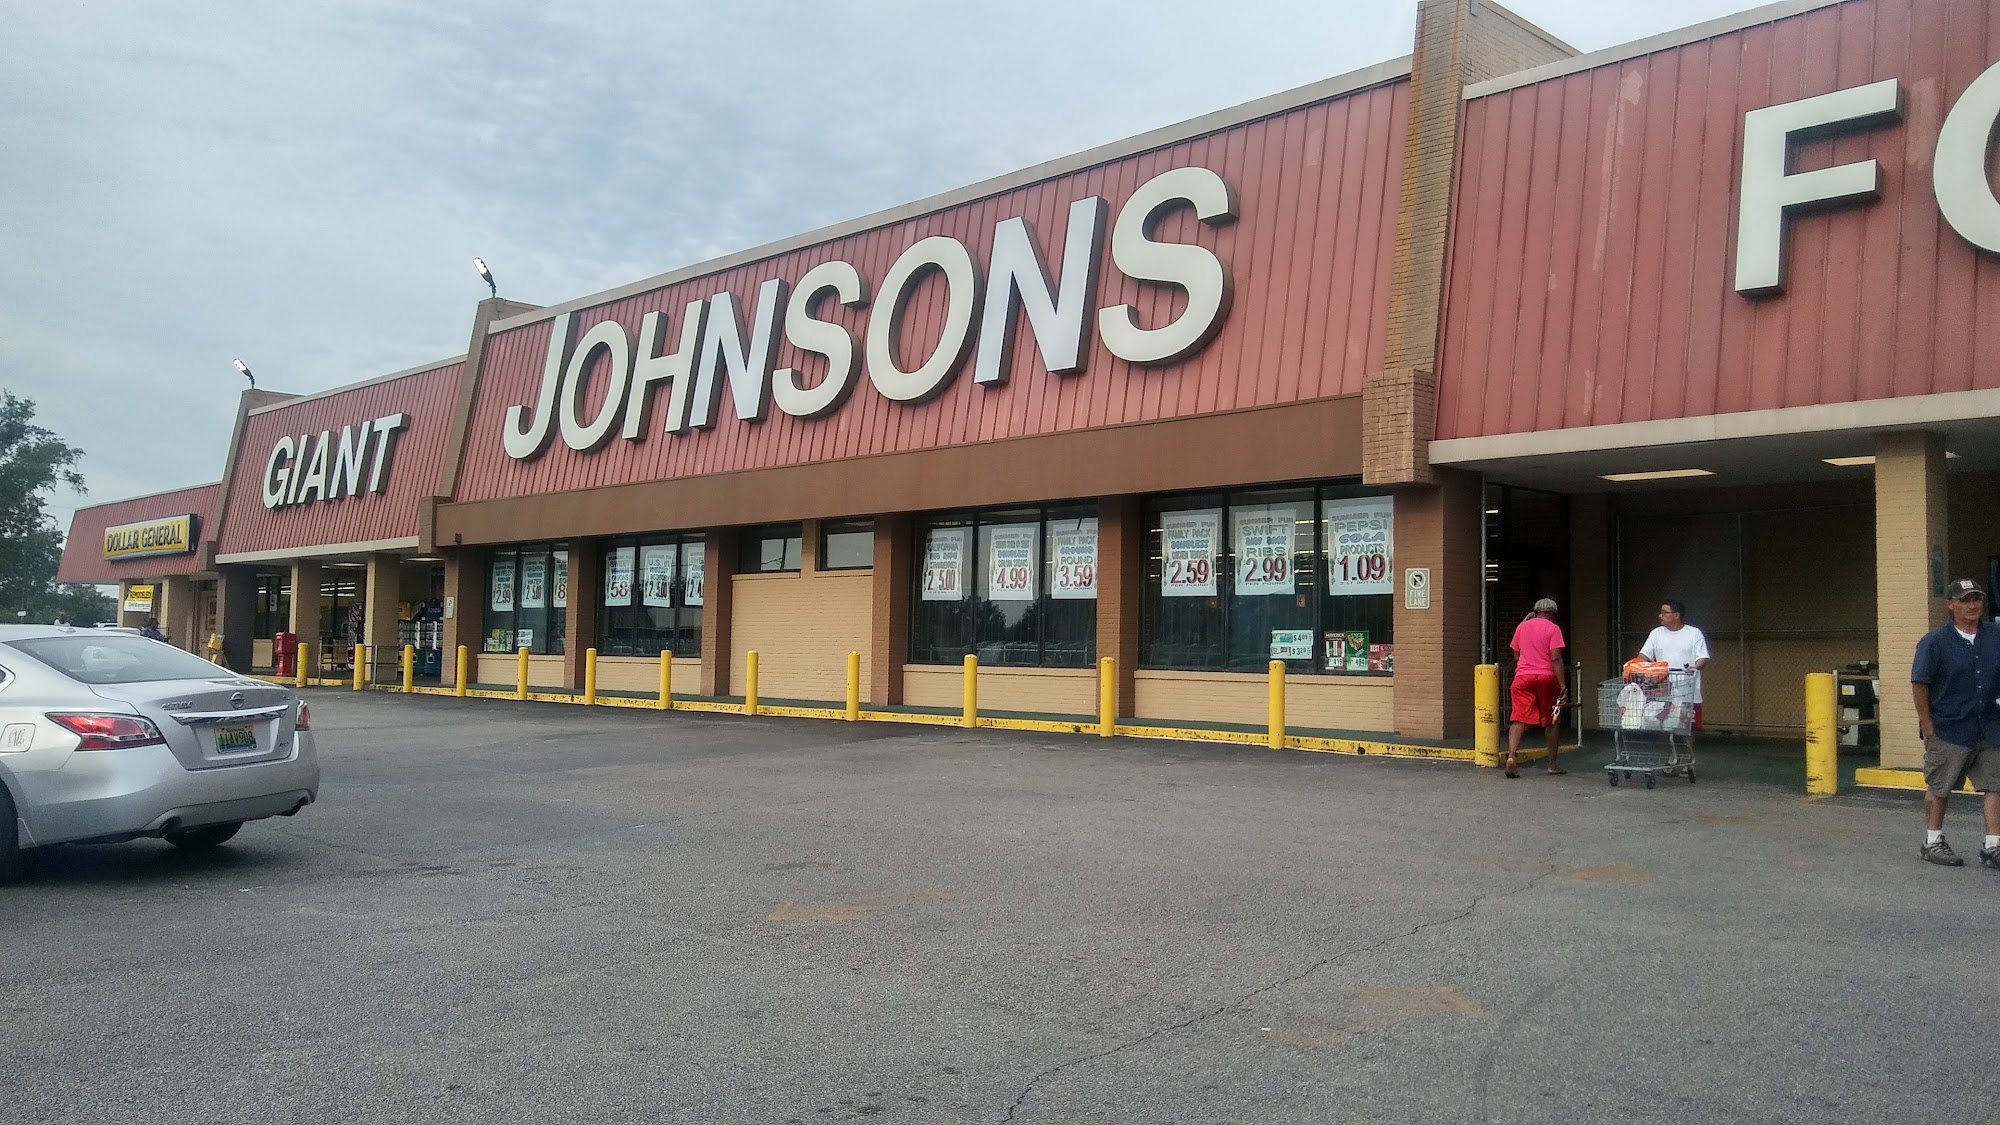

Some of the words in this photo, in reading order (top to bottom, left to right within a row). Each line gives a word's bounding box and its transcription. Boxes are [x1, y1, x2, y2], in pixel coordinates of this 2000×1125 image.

[503, 166, 1234, 461] JOHNSONS
[262, 412, 406, 510] GIANT
[1242, 524, 1289, 536] SWIFT
[1334, 519, 1388, 533] PEPSI
[107, 529, 140, 552] DOLLAR
[142, 524, 182, 548] GENERAL
[1192, 528, 1211, 538] PACK
[1339, 531, 1386, 544] COLA
[1246, 546, 1287, 558] RIBS
[1340, 543, 1385, 555] PRODUCTS
[1060, 555, 1094, 565] ROUND
[610, 580, 628, 598] 58
[1409, 589, 1426, 598] FIRE
[1409, 598, 1426, 606] LANE
